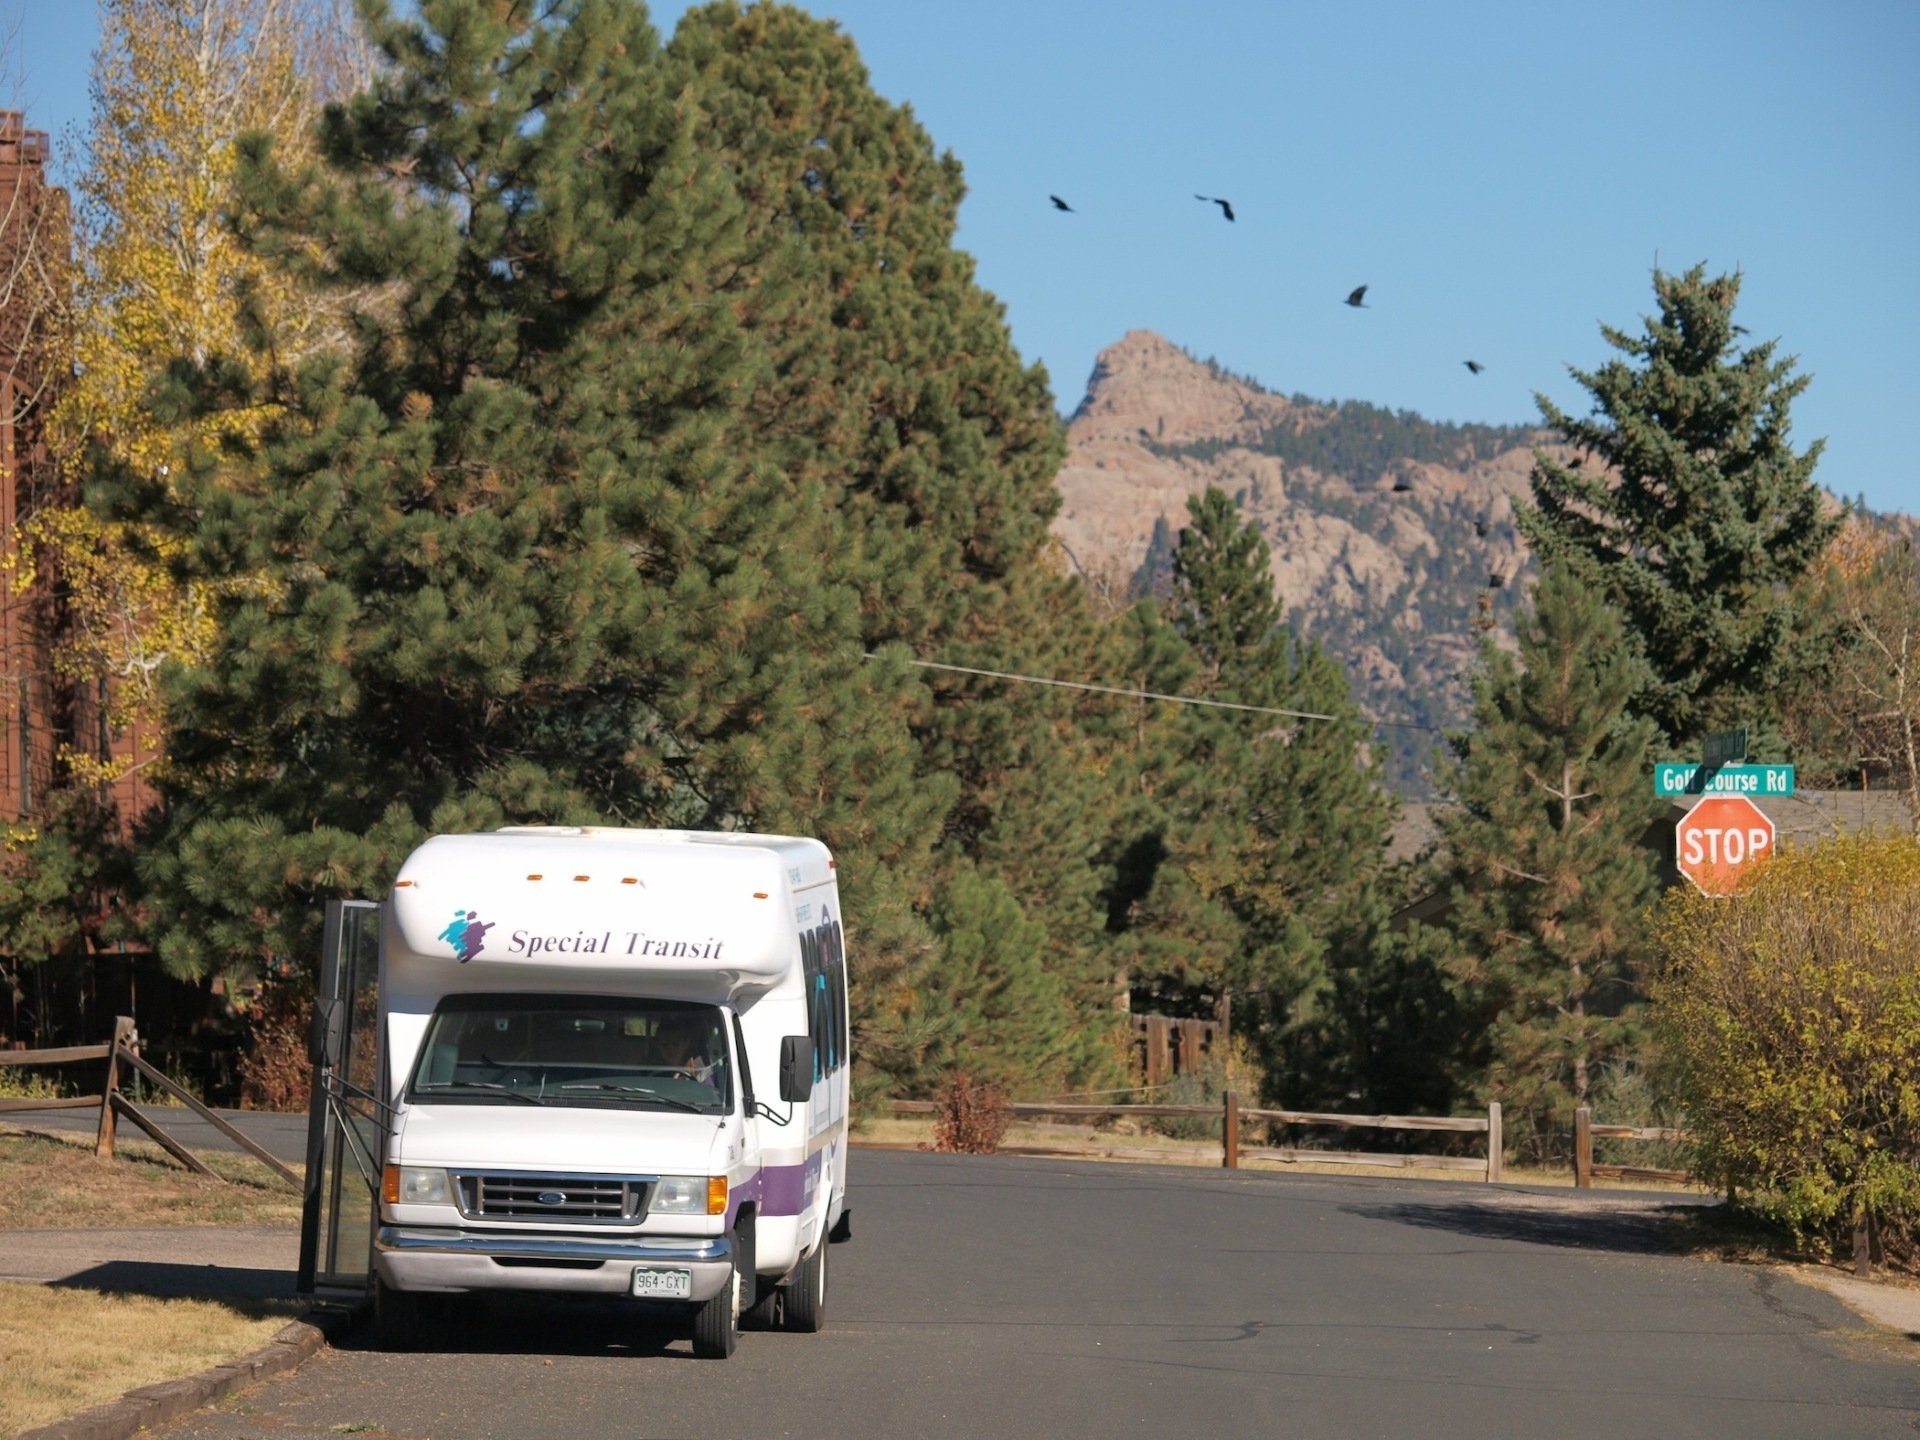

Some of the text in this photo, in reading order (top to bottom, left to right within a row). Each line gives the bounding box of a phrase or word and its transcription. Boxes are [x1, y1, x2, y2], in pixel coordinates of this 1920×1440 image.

[1766, 770, 1787, 791] Rd
[1684, 828, 1768, 865] STOP
[508, 929, 724, 960] Special Transit
